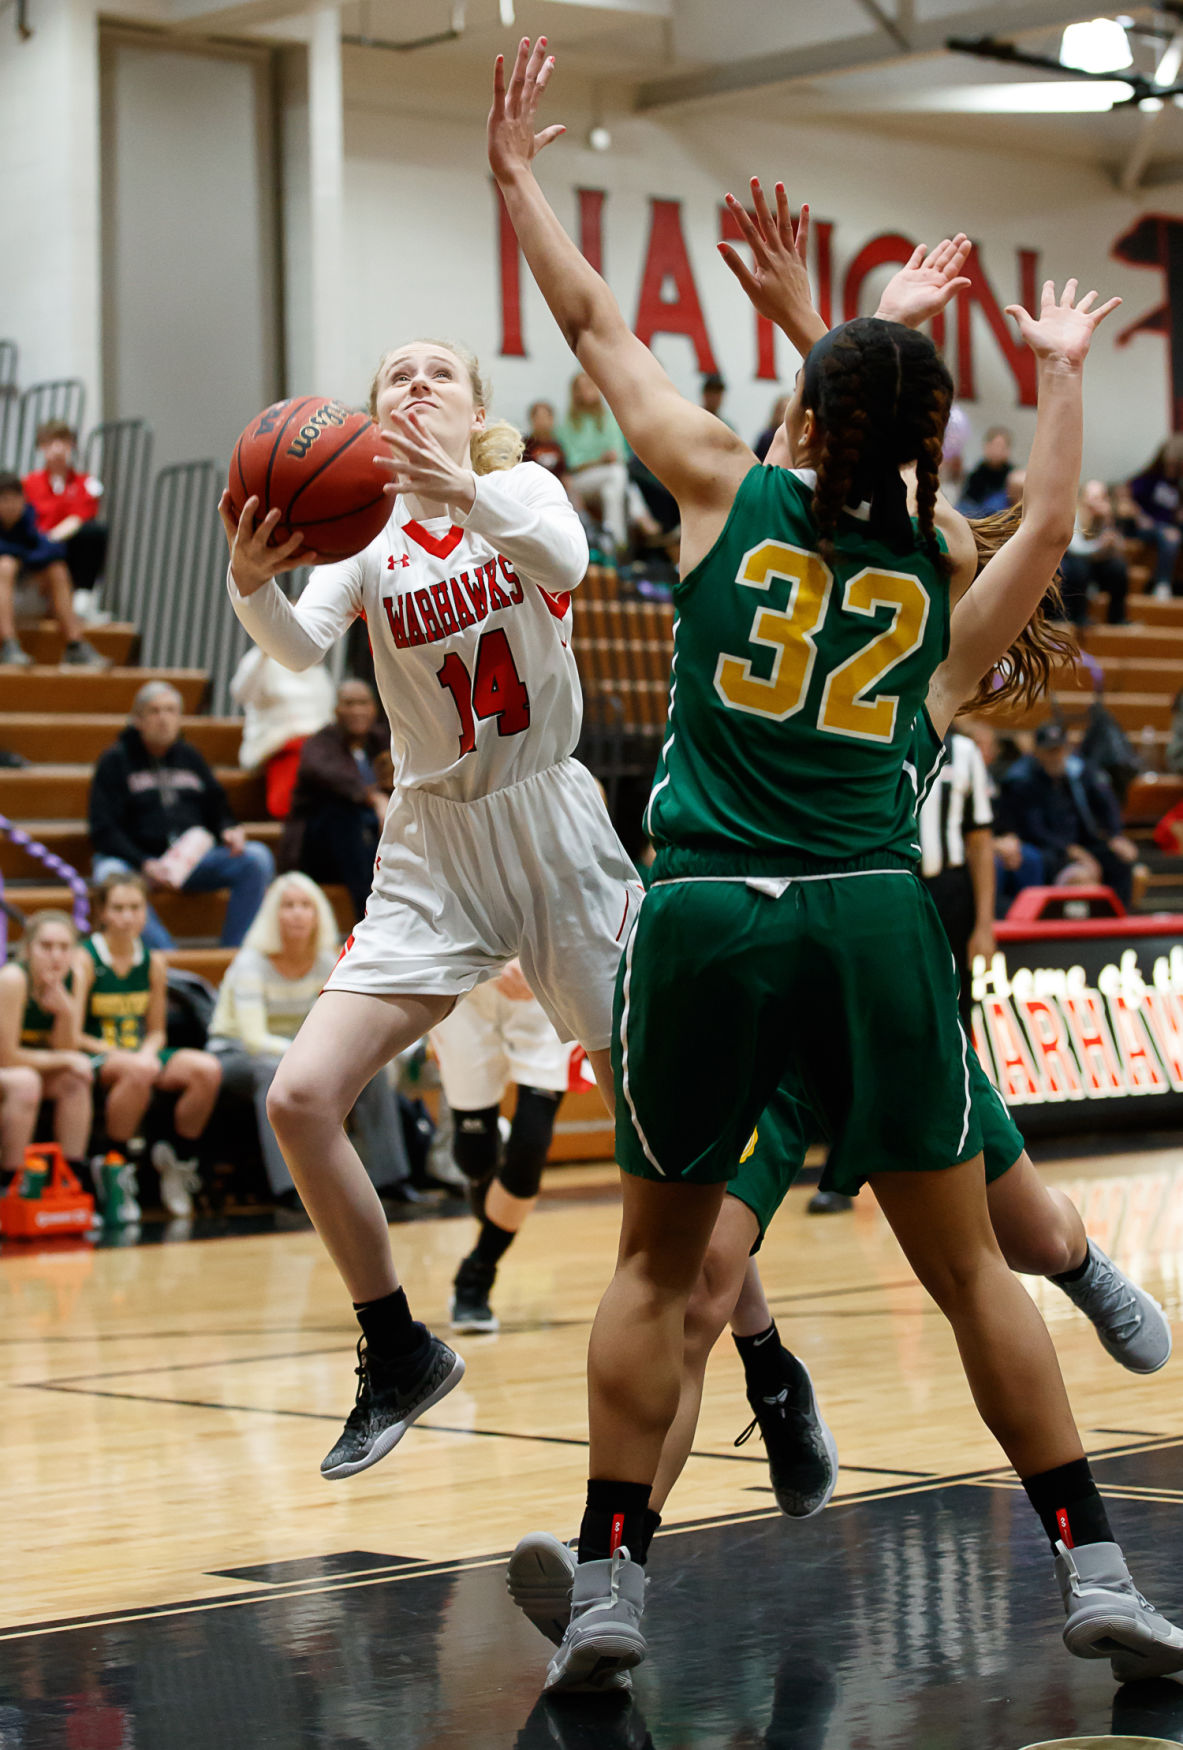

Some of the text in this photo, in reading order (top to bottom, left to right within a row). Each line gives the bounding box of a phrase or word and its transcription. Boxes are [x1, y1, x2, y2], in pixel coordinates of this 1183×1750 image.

[286, 400, 348, 459] ilson
[383, 553, 524, 649] WARHAWKS
[713, 538, 931, 743] 32
[436, 627, 531, 759] 14
